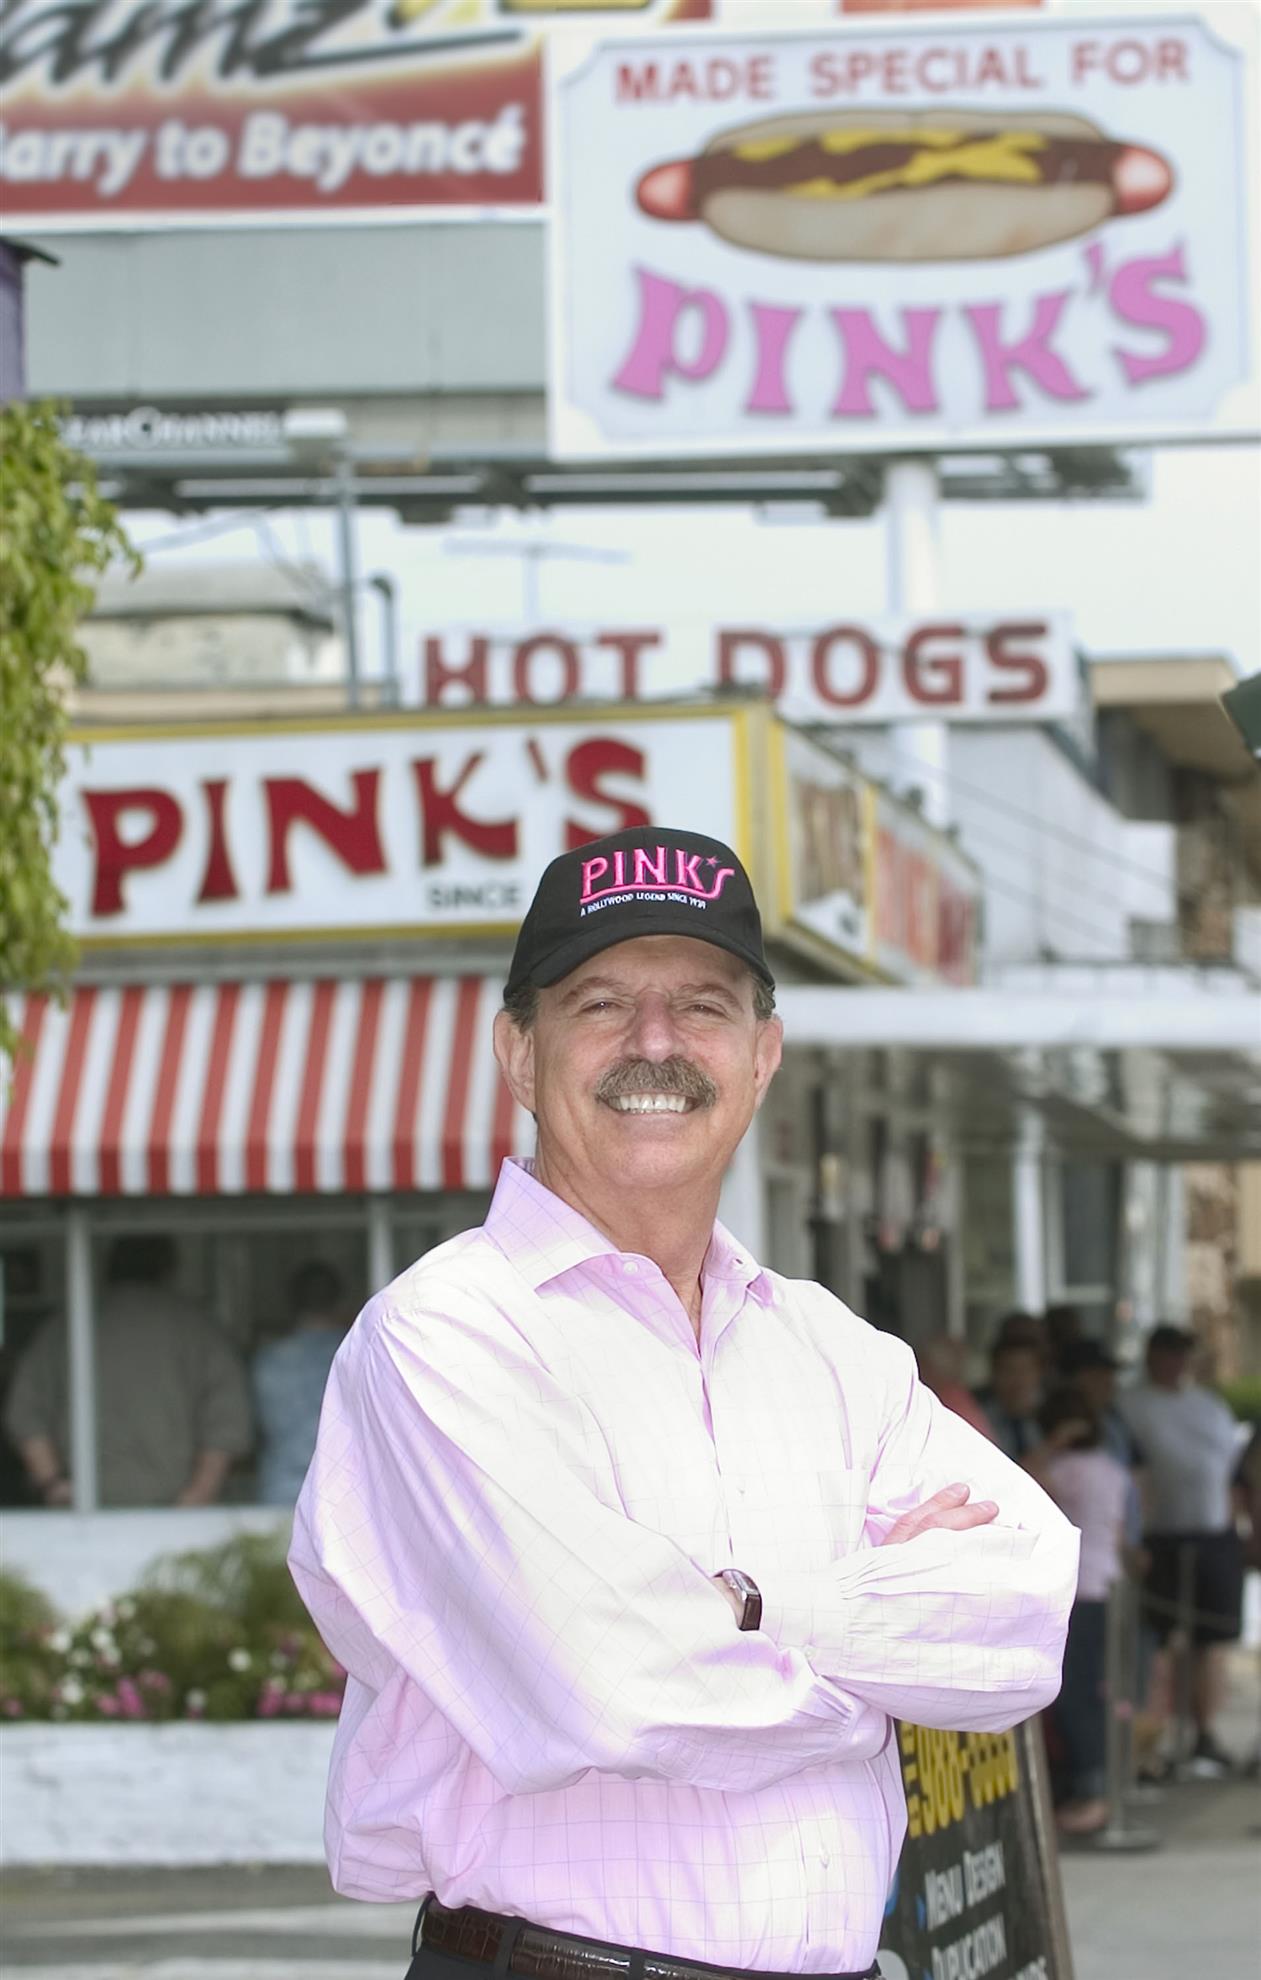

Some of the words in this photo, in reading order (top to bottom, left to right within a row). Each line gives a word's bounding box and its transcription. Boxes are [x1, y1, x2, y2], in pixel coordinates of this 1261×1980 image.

[615, 55, 775, 103] MADE
[809, 46, 1043, 97] SPECIAL
[1072, 38, 1191, 86] FOR
[0, 128, 147, 196] arry
[155, 121, 230, 179] to
[237, 104, 524, 192] Beyoncé
[610, 239, 1208, 418] PINK'S
[424, 631, 663, 707] HOT
[716, 621, 1051, 709] DOGS
[81, 737, 655, 919] PINK'S
[429, 884, 520, 908] SINCE
[587, 893, 634, 914] HOLLYWOOD
[636, 892, 666, 902] LEGEND
